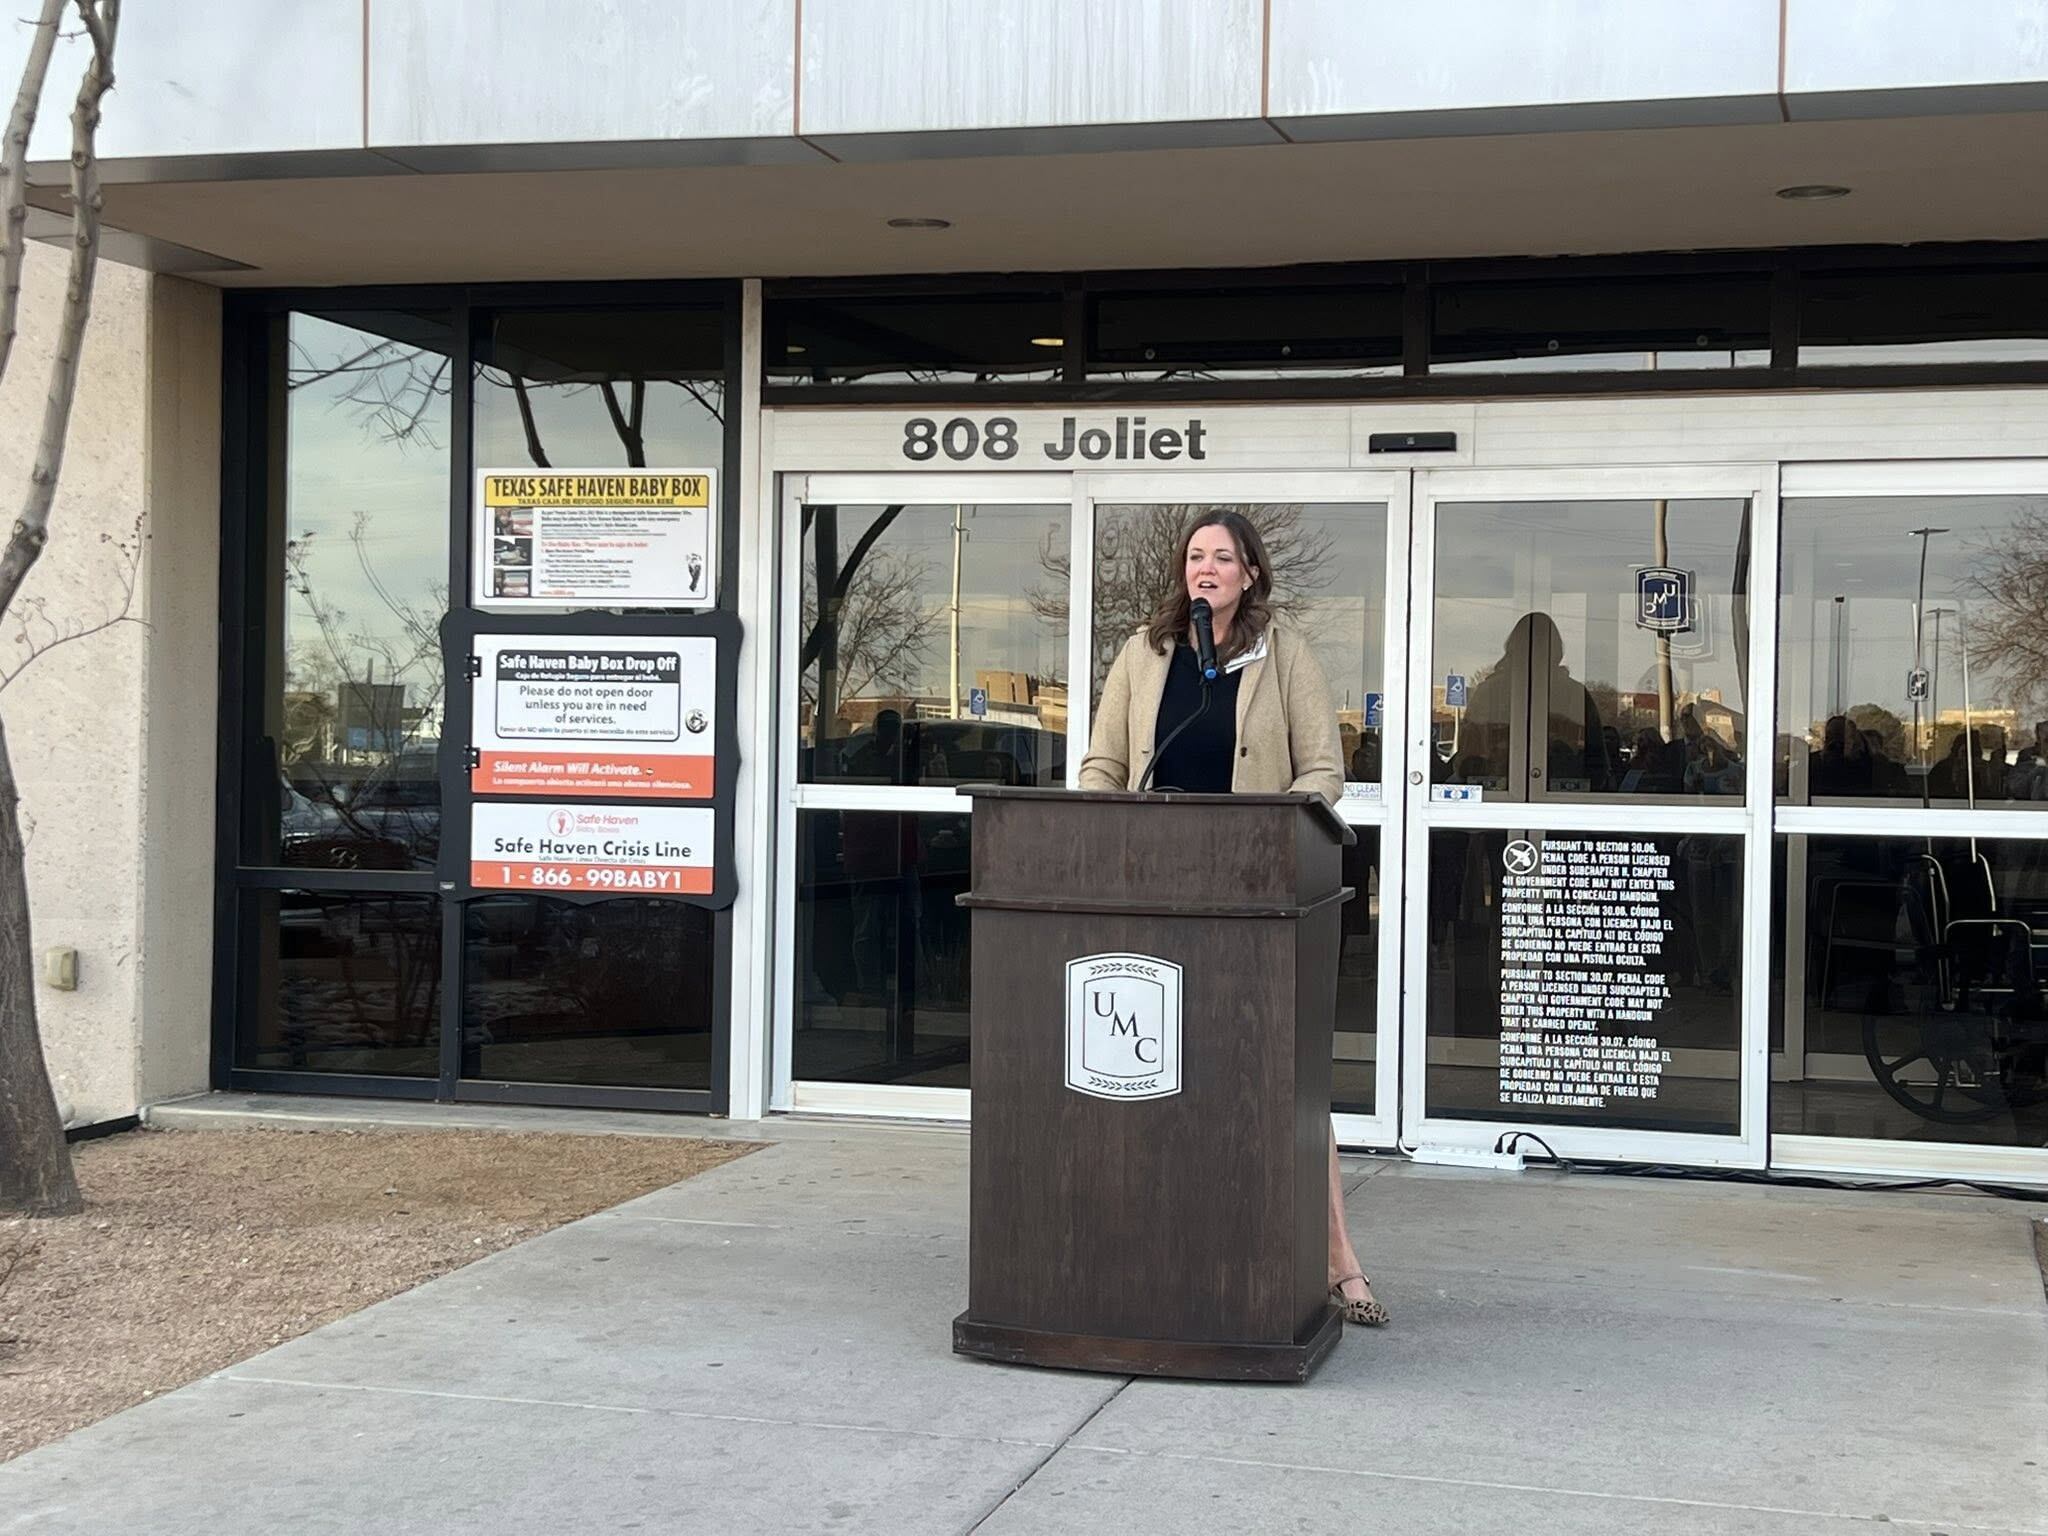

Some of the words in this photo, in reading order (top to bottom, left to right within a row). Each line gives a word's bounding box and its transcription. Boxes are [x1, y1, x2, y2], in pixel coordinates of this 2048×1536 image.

[902, 417, 1019, 461] 808
[1043, 416, 1207, 461] Joliet
[494, 478, 535, 497] TEXAS
[539, 478, 573, 497] SAFE
[577, 478, 625, 497] HAVEN
[630, 478, 669, 497] BABY
[672, 478, 701, 497] BOX
[500, 655, 527, 669] Safe
[529, 655, 566, 669] Haven
[568, 656, 599, 672] Baby
[600, 656, 624, 670] Box
[625, 657, 655, 673] Drop
[657, 656, 677, 671] Off
[520, 685, 555, 696] Please
[557, 685, 571, 696] do
[575, 687, 593, 697] not
[596, 688, 624, 699] open
[627, 687, 653, 698] door
[525, 699, 560, 710] unless
[563, 702, 583, 713] you
[585, 702, 603, 710] are
[606, 701, 616, 711] in
[619, 701, 647, 711] need
[555, 713, 567, 724] of
[569, 714, 617, 724] services.
[494, 760, 528, 773] Silent
[528, 761, 564, 774] Alarm
[566, 762, 590, 774] Will
[591, 763, 643, 776] Activate.
[576, 814, 601, 824] Safe
[603, 815, 639, 824] Haven
[494, 837, 534, 854] Safe
[540, 838, 598, 855] Haven
[603, 840, 650, 857] Crisis
[655, 841, 692, 858] Line
[1541, 840, 1582, 852] PURSUANT
[1584, 841, 1594, 851] TO
[1596, 842, 1629, 852] SECTION
[1541, 852, 1566, 863] PENAL
[1568, 853, 1588, 864] CODE
[1591, 854, 1597, 863] A
[1599, 854, 1630, 864] PERSON
[1632, 855, 1670, 866] LICENSED
[1541, 864, 1567, 875] UNDER
[1570, 865, 1619, 877] SUBCHAPTER
[1633, 867, 1667, 878] CHAPTER
[1503, 876, 1514, 885] 411
[1516, 876, 1567, 888] GOVERNMENT
[1570, 877, 1589, 888] CODE
[1592, 878, 1609, 888] MAY
[1612, 879, 1627, 889] NOT
[1629, 879, 1654, 890] ENTER
[1657, 880, 1675, 890] THIS
[1502, 887, 1541, 898] PROPERTY
[1543, 889, 1562, 899] WITH
[1564, 890, 1570, 899] A
[1573, 889, 1617, 901] CONCEALED
[1620, 891, 1659, 902] HANDGUN.
[1502, 902, 1543, 914] CONFORME
[1546, 904, 1552, 913] A
[1554, 904, 1564, 914] LA
[1502, 915, 1526, 925] PENAL
[1528, 915, 1544, 926] UNA
[1547, 916, 1582, 927] PERSONA
[1585, 917, 1601, 928] CON
[1603, 918, 1638, 929] LICENCIA
[1641, 919, 1661, 930] BAJO
[1664, 920, 1673, 930] EL
[1604, 930, 1615, 940] 411
[1618, 931, 1632, 941] DEL
[1502, 939, 1512, 949] DE
[1514, 939, 1552, 950] GOBIERNO
[1554, 941, 1566, 950] NO
[1568, 941, 1592, 951] PUEDE
[1595, 942, 1625, 953] ENTRAR
[1628, 943, 1639, 953] EN
[1642, 944, 1661, 954] ESTA
[1501, 951, 1543, 962] PROPIEDAD
[1546, 952, 1561, 962] CON
[1564, 953, 1580, 963] UNA
[1582, 954, 1613, 964] PISTOLA
[1616, 955, 1646, 966] OCULTA.
[1501, 969, 1541, 980] PURSUANT
[1543, 970, 1553, 980] TO
[1556, 970, 1588, 982] SECTION
[1617, 973, 1642, 984] PENAL
[1645, 974, 1665, 984] CODE
[1501, 981, 1507, 990] A
[1509, 981, 1539, 992] PERSON
[1542, 982, 1579, 993] LICENSED
[1582, 984, 1607, 994] UNDER
[1610, 985, 1660, 997] SUBCHAPTER
[1501, 993, 1535, 1004] CHAPTER
[1538, 994, 1548, 1004] 411
[1551, 995, 1602, 1006] GOVERNMENT
[1605, 997, 1625, 1007] CODE
[1628, 998, 1645, 1008] MAY
[1647, 999, 1663, 1009] NOT
[1501, 1005, 1524, 1015] ENTER
[1526, 1006, 1544, 1016] THIS
[1546, 1007, 1584, 1018] PROPERTY
[1587, 1008, 1605, 1018] WITH
[1608, 1010, 1614, 1019] A
[1616, 1010, 1652, 1021] HANDGUN
[1093, 991, 1158, 1064] UMC
[1501, 1017, 1520, 1027] THAT
[1522, 1018, 1530, 1028] IS
[1532, 1018, 1565, 1029] CARRIED
[1568, 1020, 1598, 1030] OPENLY.
